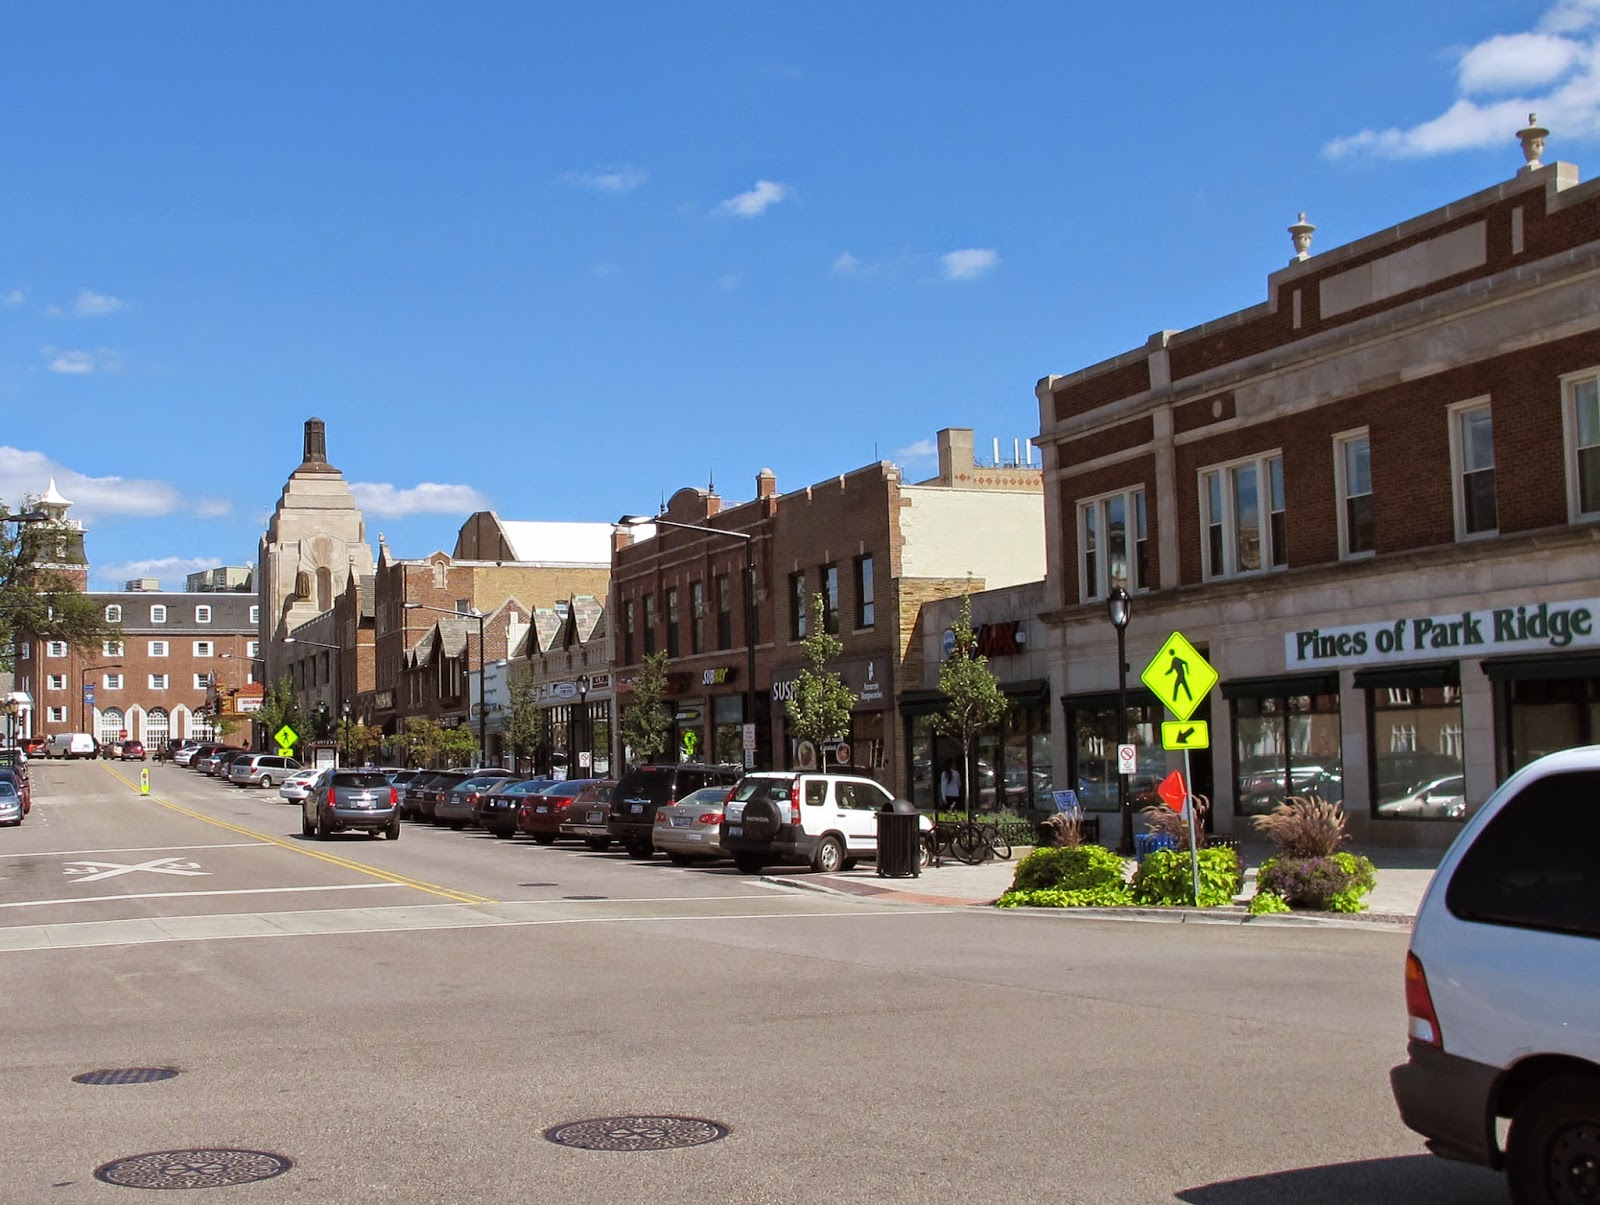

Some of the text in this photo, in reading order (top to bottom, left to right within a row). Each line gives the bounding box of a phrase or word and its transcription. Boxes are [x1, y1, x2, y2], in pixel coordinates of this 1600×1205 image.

[1296, 603, 1593, 661] Pines of Park Ridge
[702, 667, 728, 685] SUBWAY
